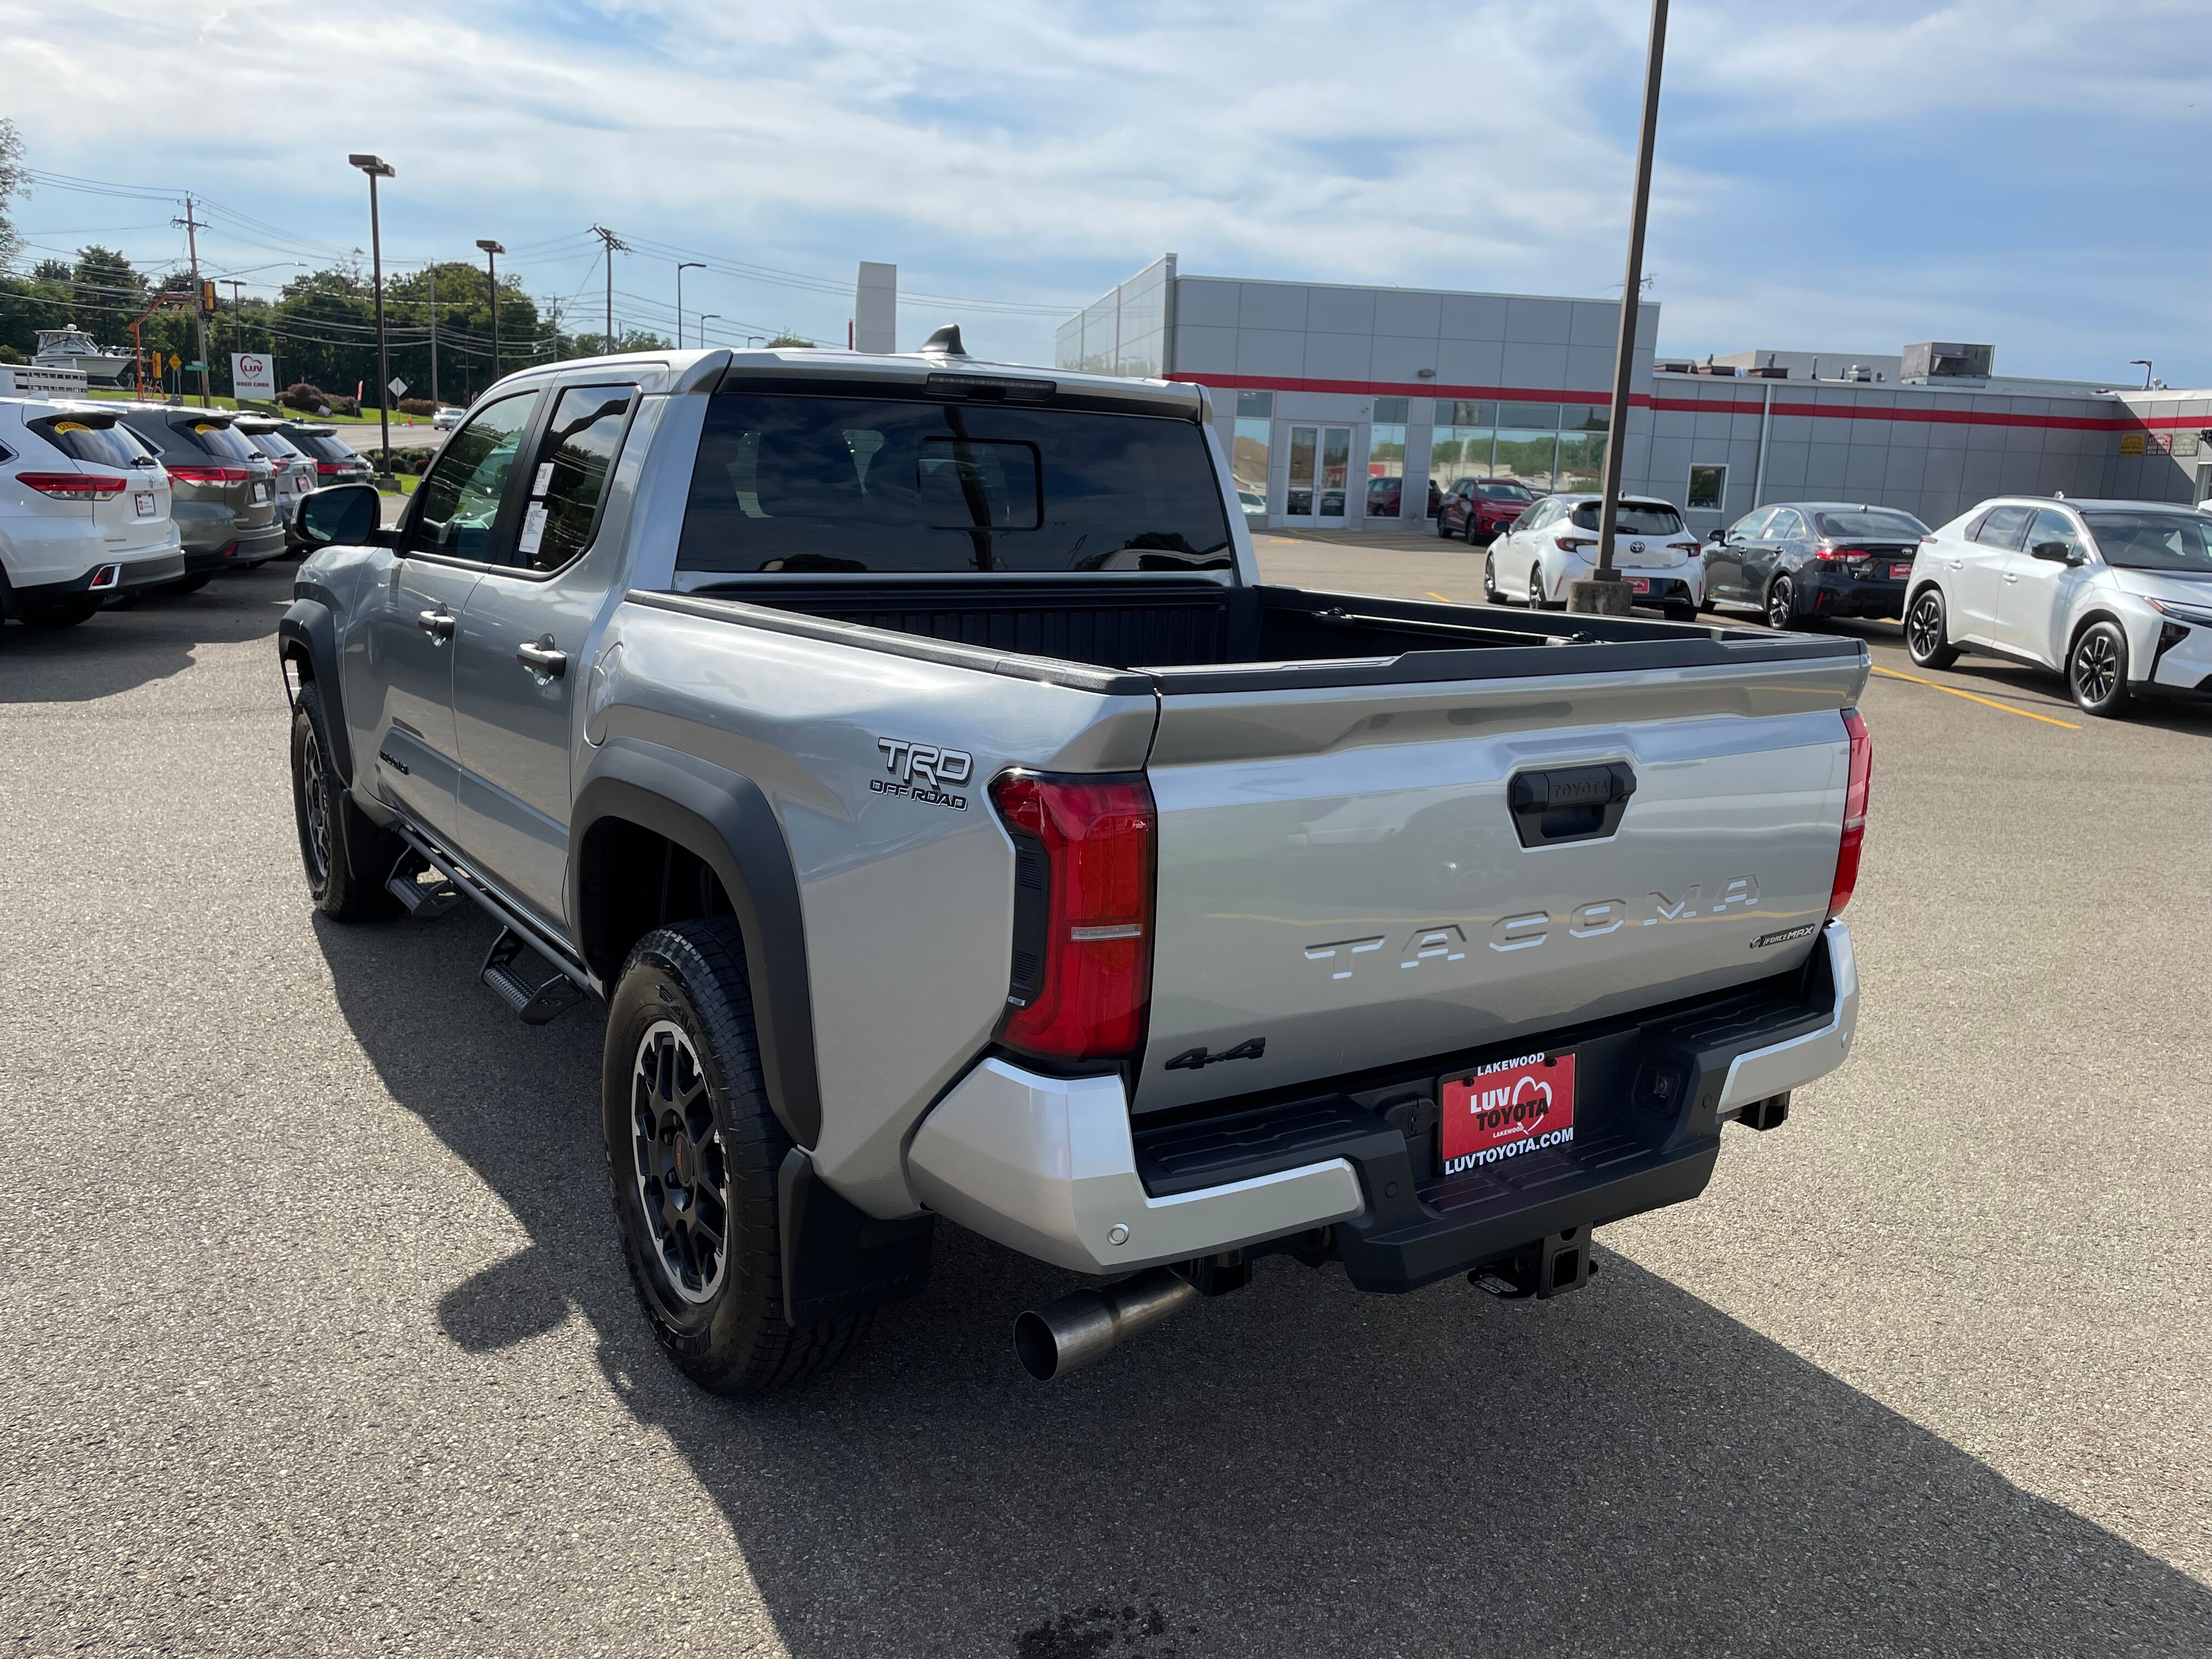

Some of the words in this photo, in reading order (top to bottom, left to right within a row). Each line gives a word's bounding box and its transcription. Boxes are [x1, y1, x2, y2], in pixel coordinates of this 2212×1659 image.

[878, 737, 973, 790] TRD
[870, 779, 910, 798] OFF
[911, 787, 969, 811] ROAD
[1553, 780, 1609, 799] TOYOTA
[1305, 874, 1760, 979] TACOMA
[1477, 1052, 1545, 1076] LAKEWOOD
[1470, 1086, 1511, 1114] LUV
[1476, 1098, 1549, 1132] TOYOTA
[1493, 1125, 1525, 1139] LAKEWOOD
[1445, 1127, 1573, 1175] LUVTOYOTA.COM
